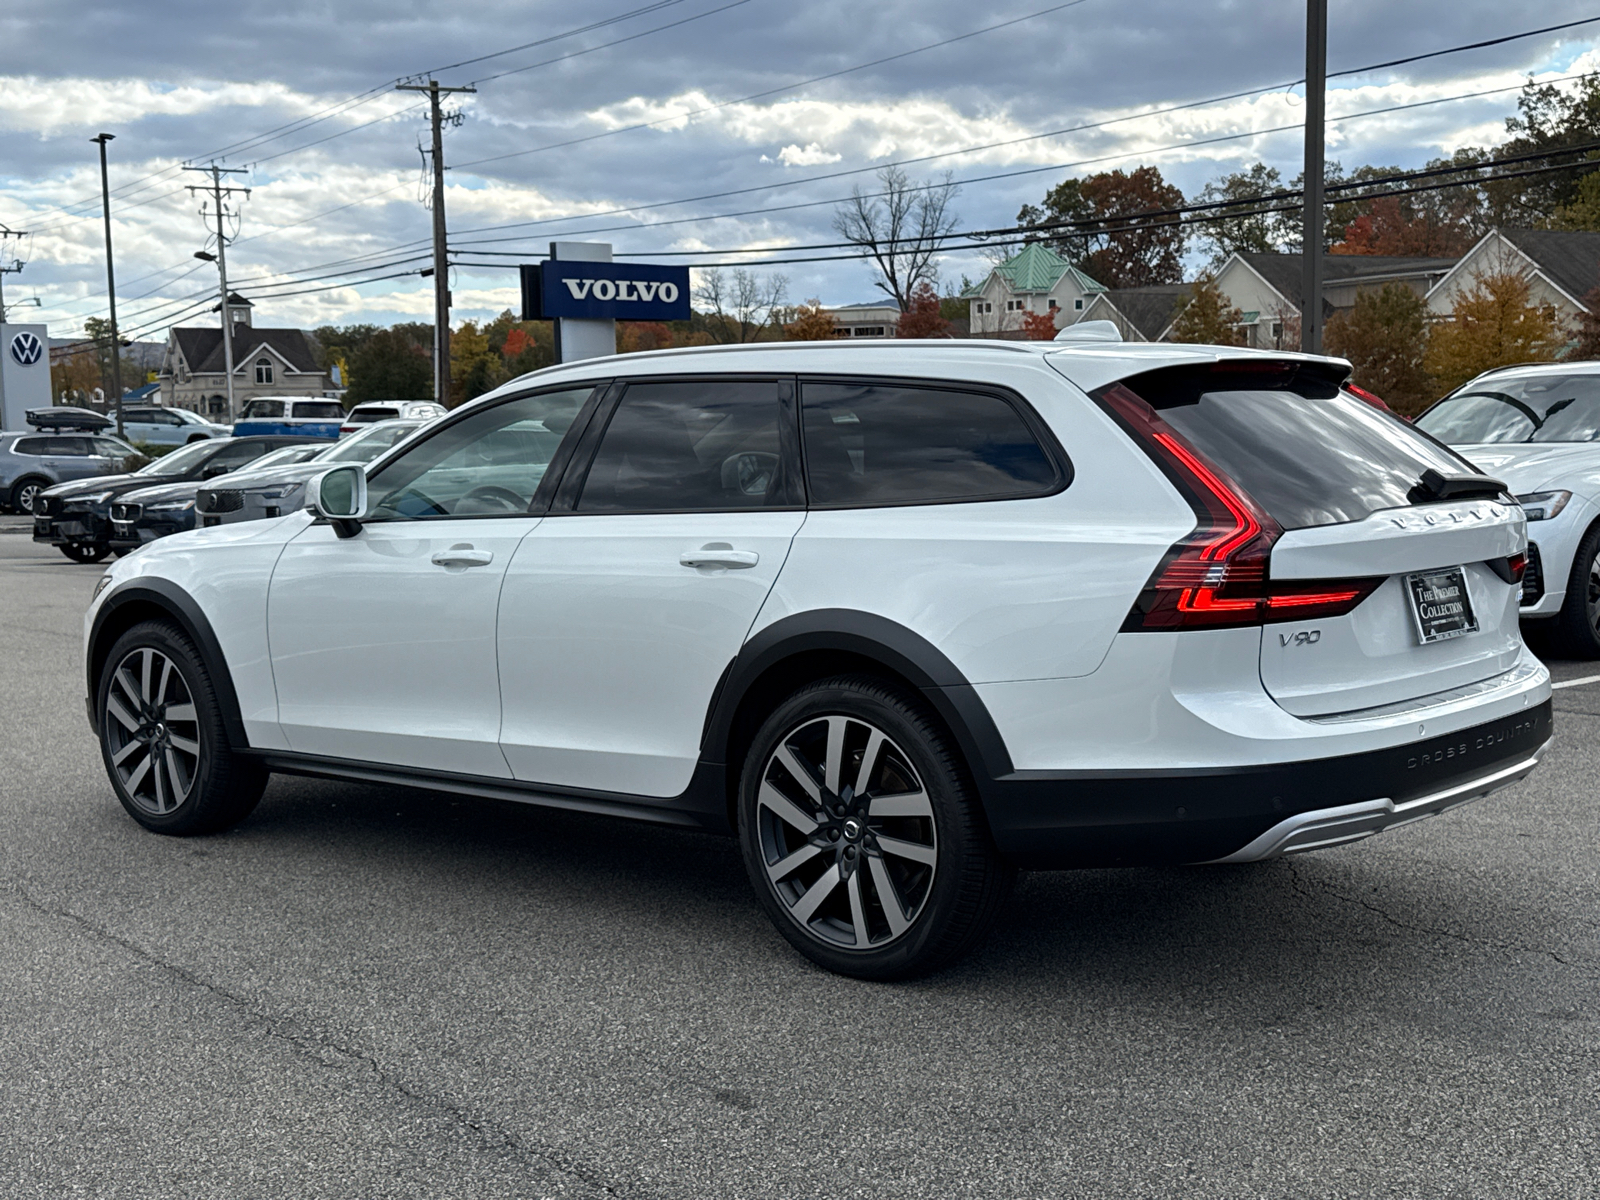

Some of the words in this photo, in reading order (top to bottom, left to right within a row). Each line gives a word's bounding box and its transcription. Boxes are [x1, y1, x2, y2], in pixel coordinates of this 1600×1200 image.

[562, 279, 679, 303] VOLVO
[10, 331, 42, 365] VW
[1391, 507, 1503, 529] VOLVO
[1417, 587, 1434, 602] THE
[1432, 585, 1460, 600] PREMIER
[1420, 602, 1464, 619] COLLECTION
[1279, 630, 1321, 647] V90
[1407, 743, 1467, 769] CROSS
[1475, 718, 1538, 749] COUNTRY
